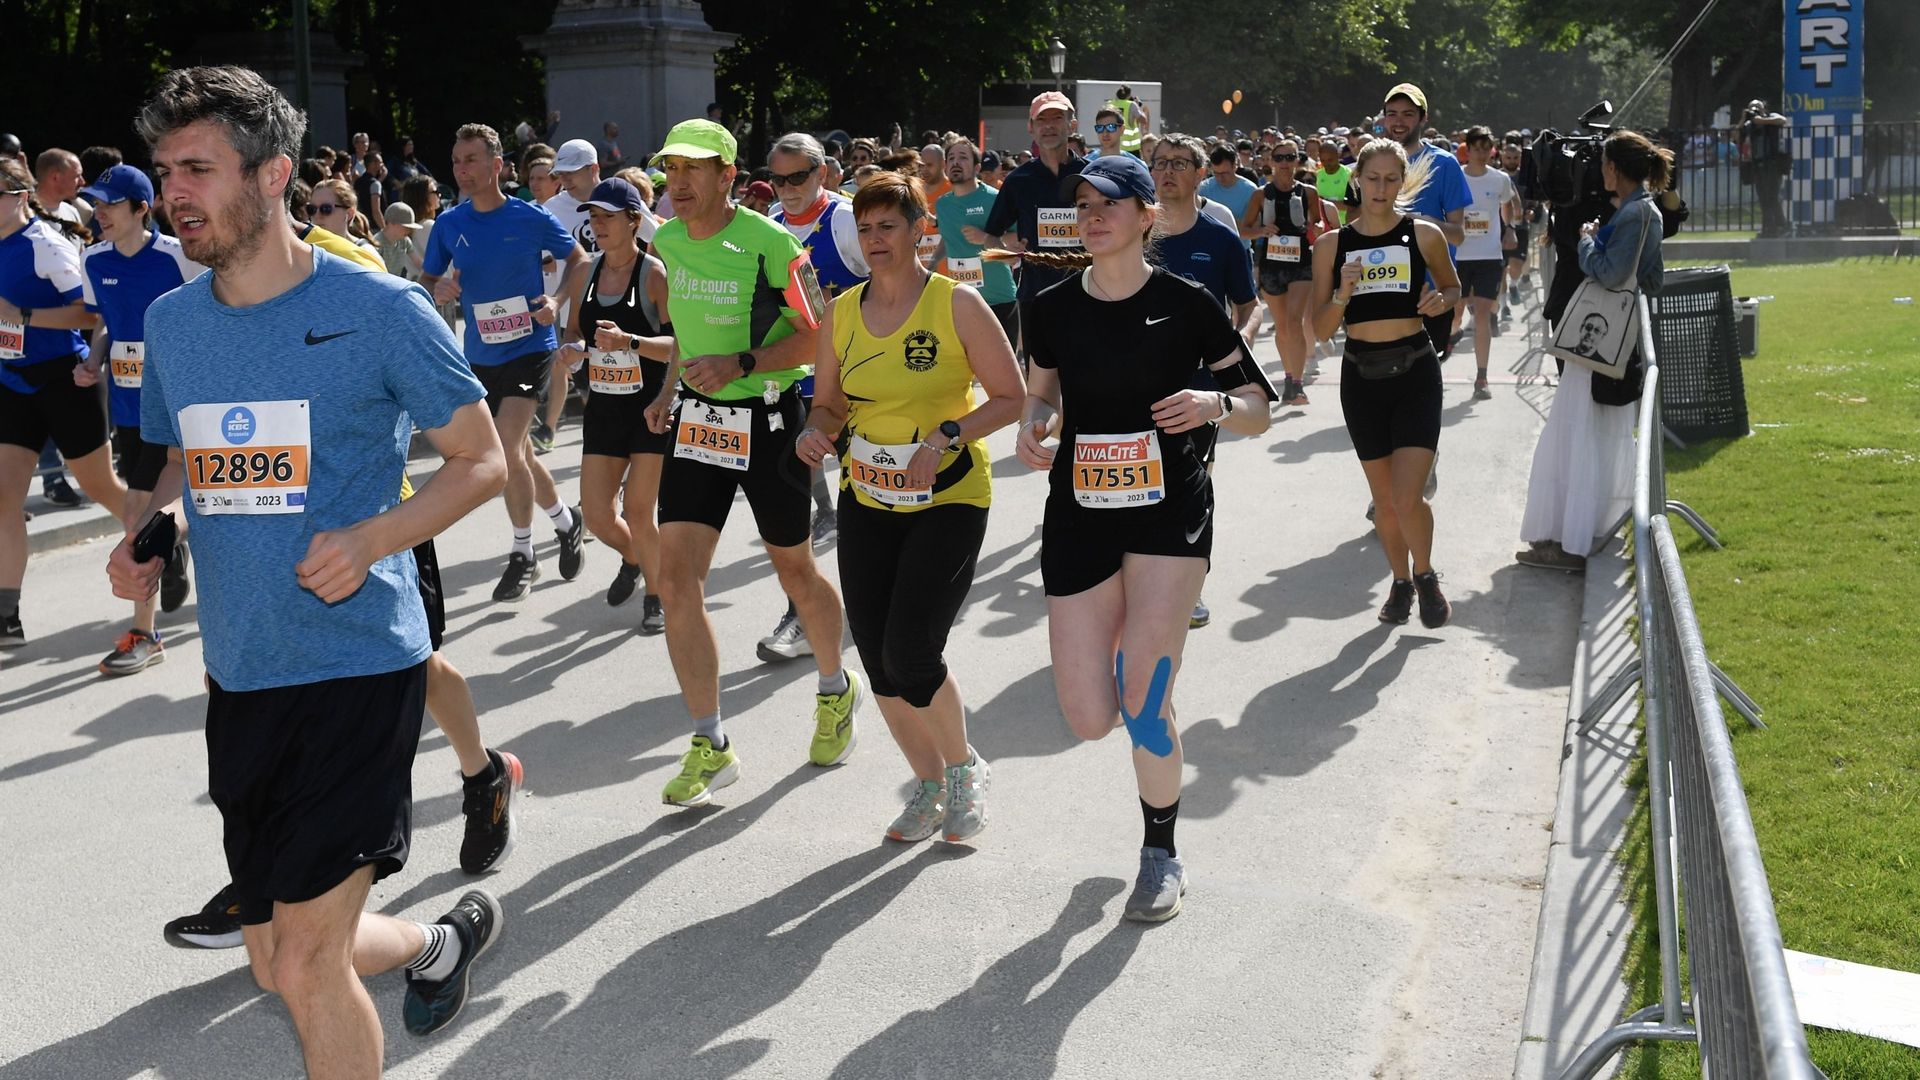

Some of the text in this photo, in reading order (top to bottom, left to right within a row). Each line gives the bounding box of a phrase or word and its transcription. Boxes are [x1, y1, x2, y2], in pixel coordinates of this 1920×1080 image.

[1798, 0, 1851, 83] RT
[1040, 212, 1076, 220] GARMI
[701, 280, 738, 293] cours
[713, 294, 738, 304] forme
[490, 308, 507, 316] SPA
[483, 316, 524, 332] 41212
[0, 334, 16, 348] 02
[602, 357, 617, 365] SPA
[593, 368, 633, 381] 12577
[705, 413, 724, 425] SPA
[228, 423, 250, 431] KBC
[689, 427, 740, 451] 12454
[720, 456, 734, 464] 2023
[872, 455, 897, 466] SPA
[194, 451, 294, 484] 12896
[859, 465, 906, 489] 1210
[1081, 465, 1149, 487] 17551
[255, 495, 281, 506] 2023
[1127, 493, 1145, 502] 2023
